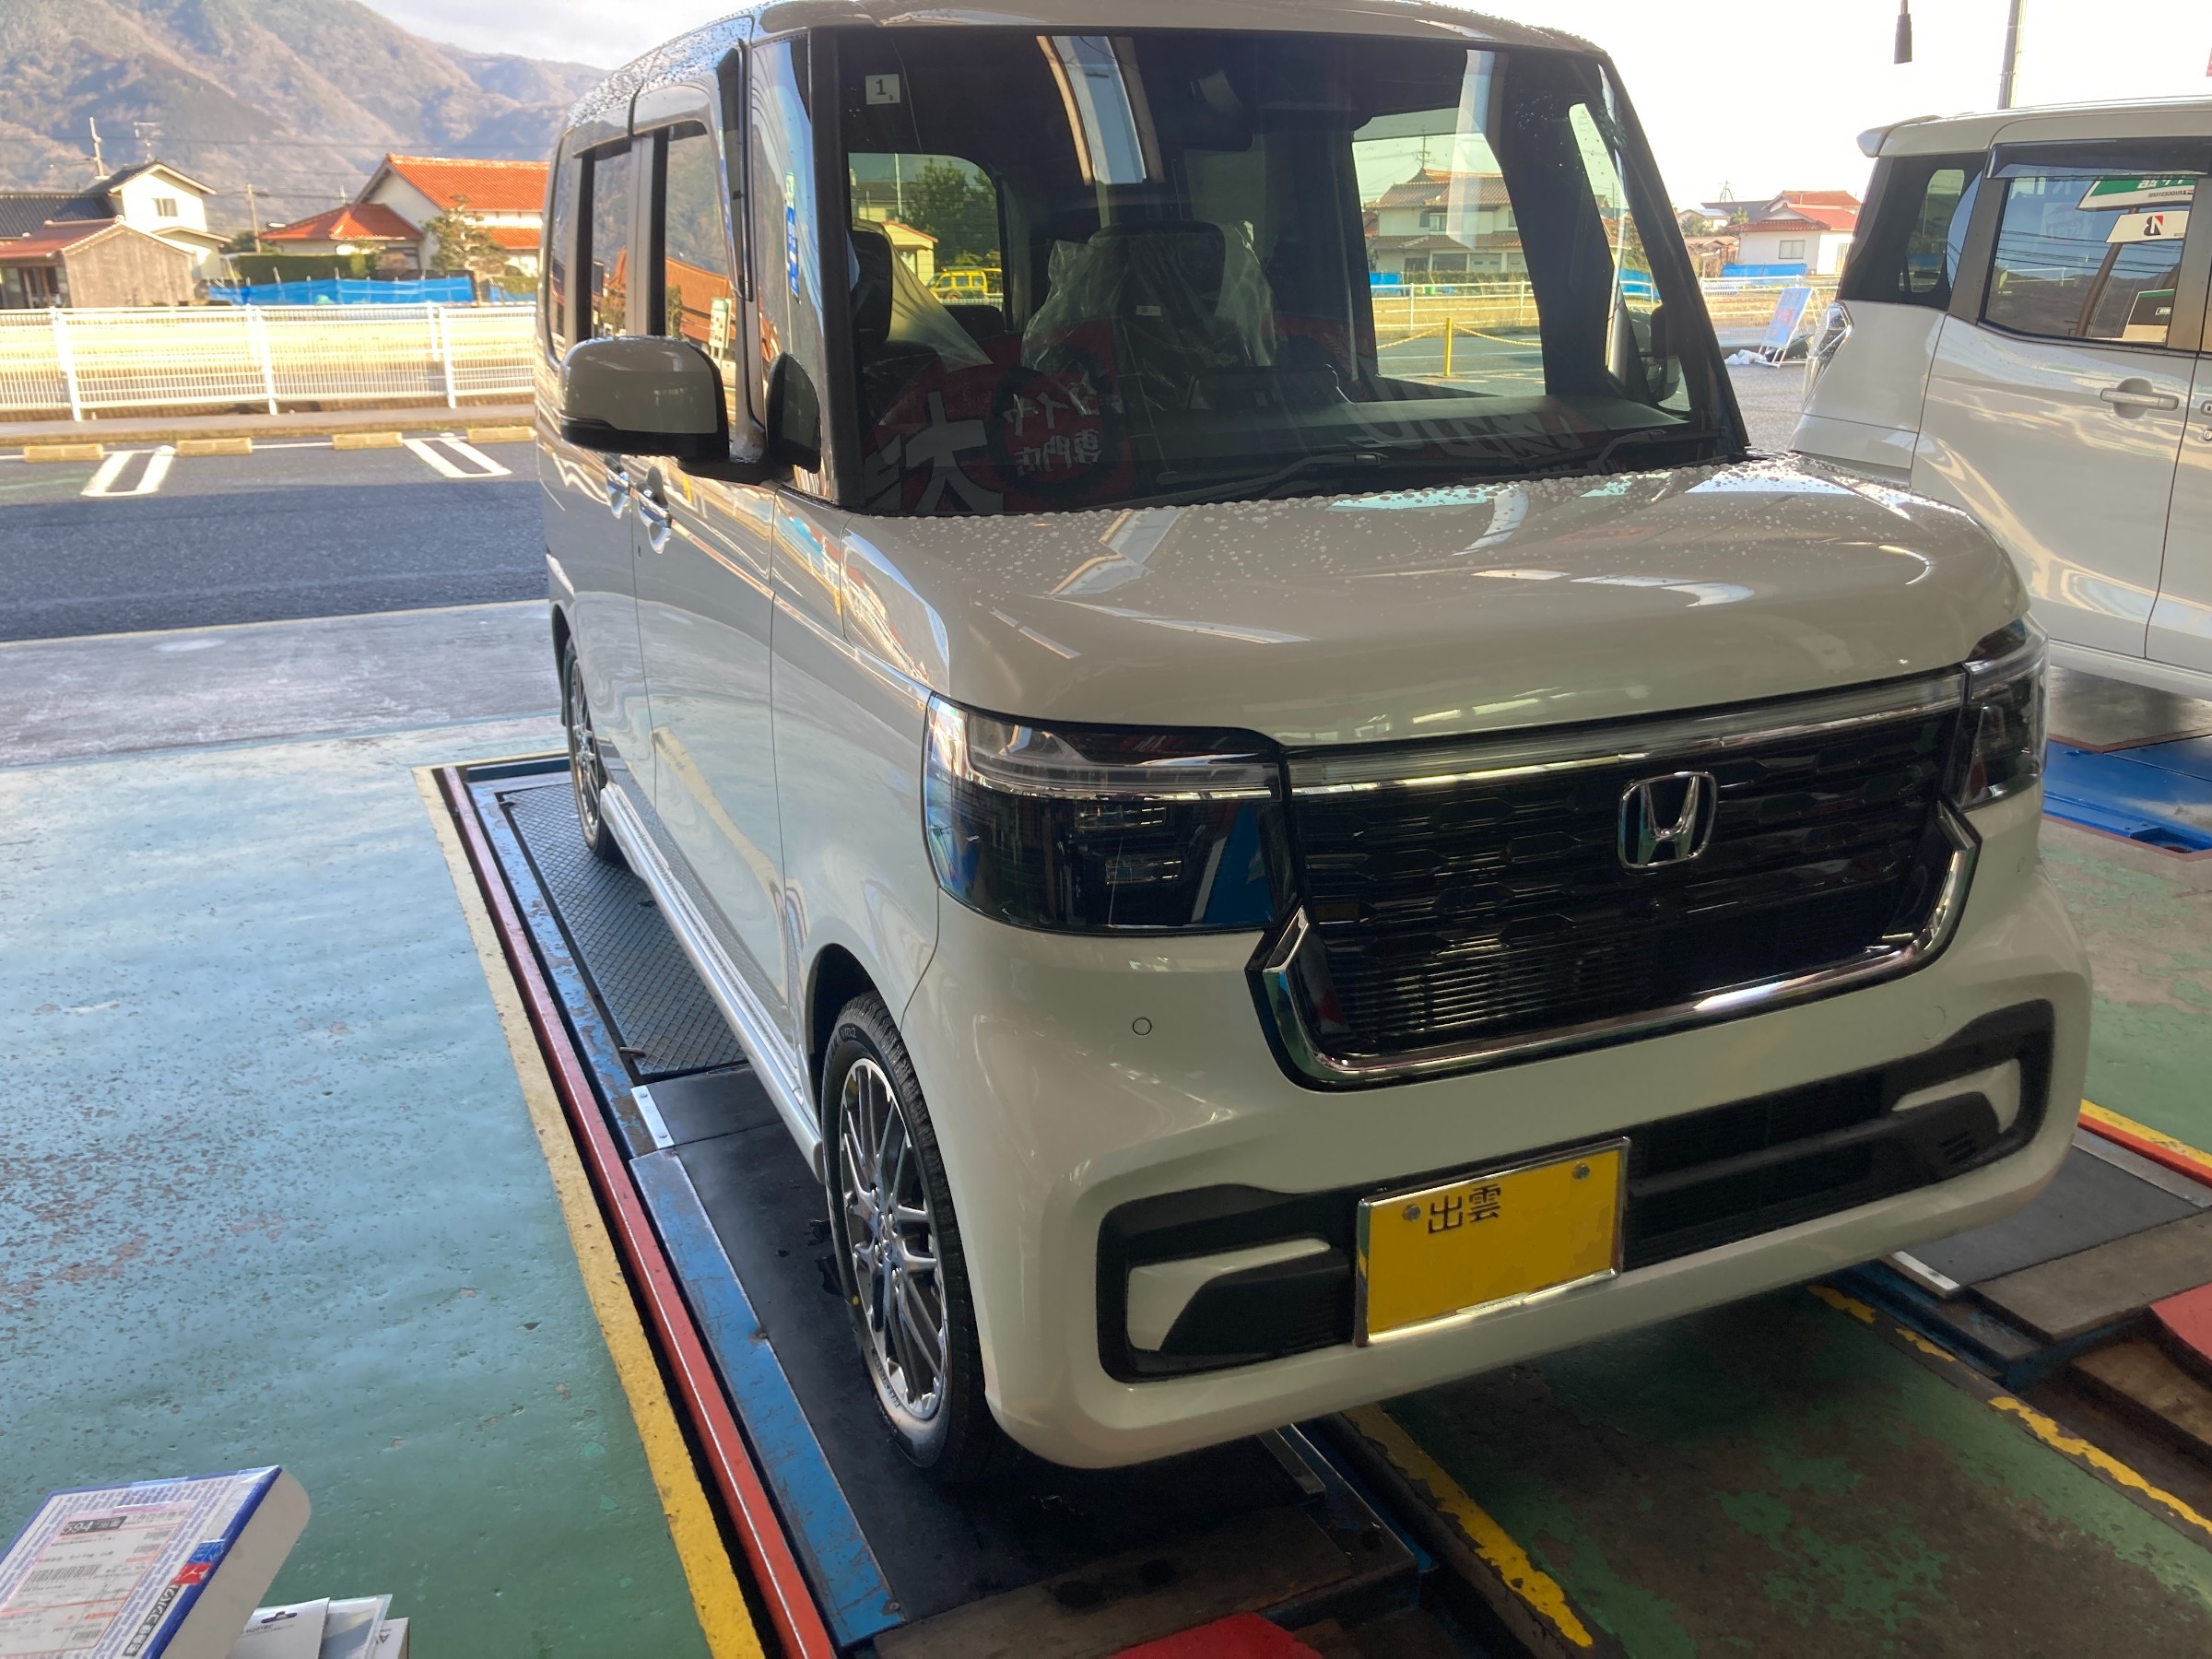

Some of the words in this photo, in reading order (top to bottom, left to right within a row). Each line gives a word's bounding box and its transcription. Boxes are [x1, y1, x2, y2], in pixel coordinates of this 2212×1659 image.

[876, 78, 887, 96] 1
[1428, 1182, 1501, 1235] 出雲
[62, 1521, 92, 1535] 594
